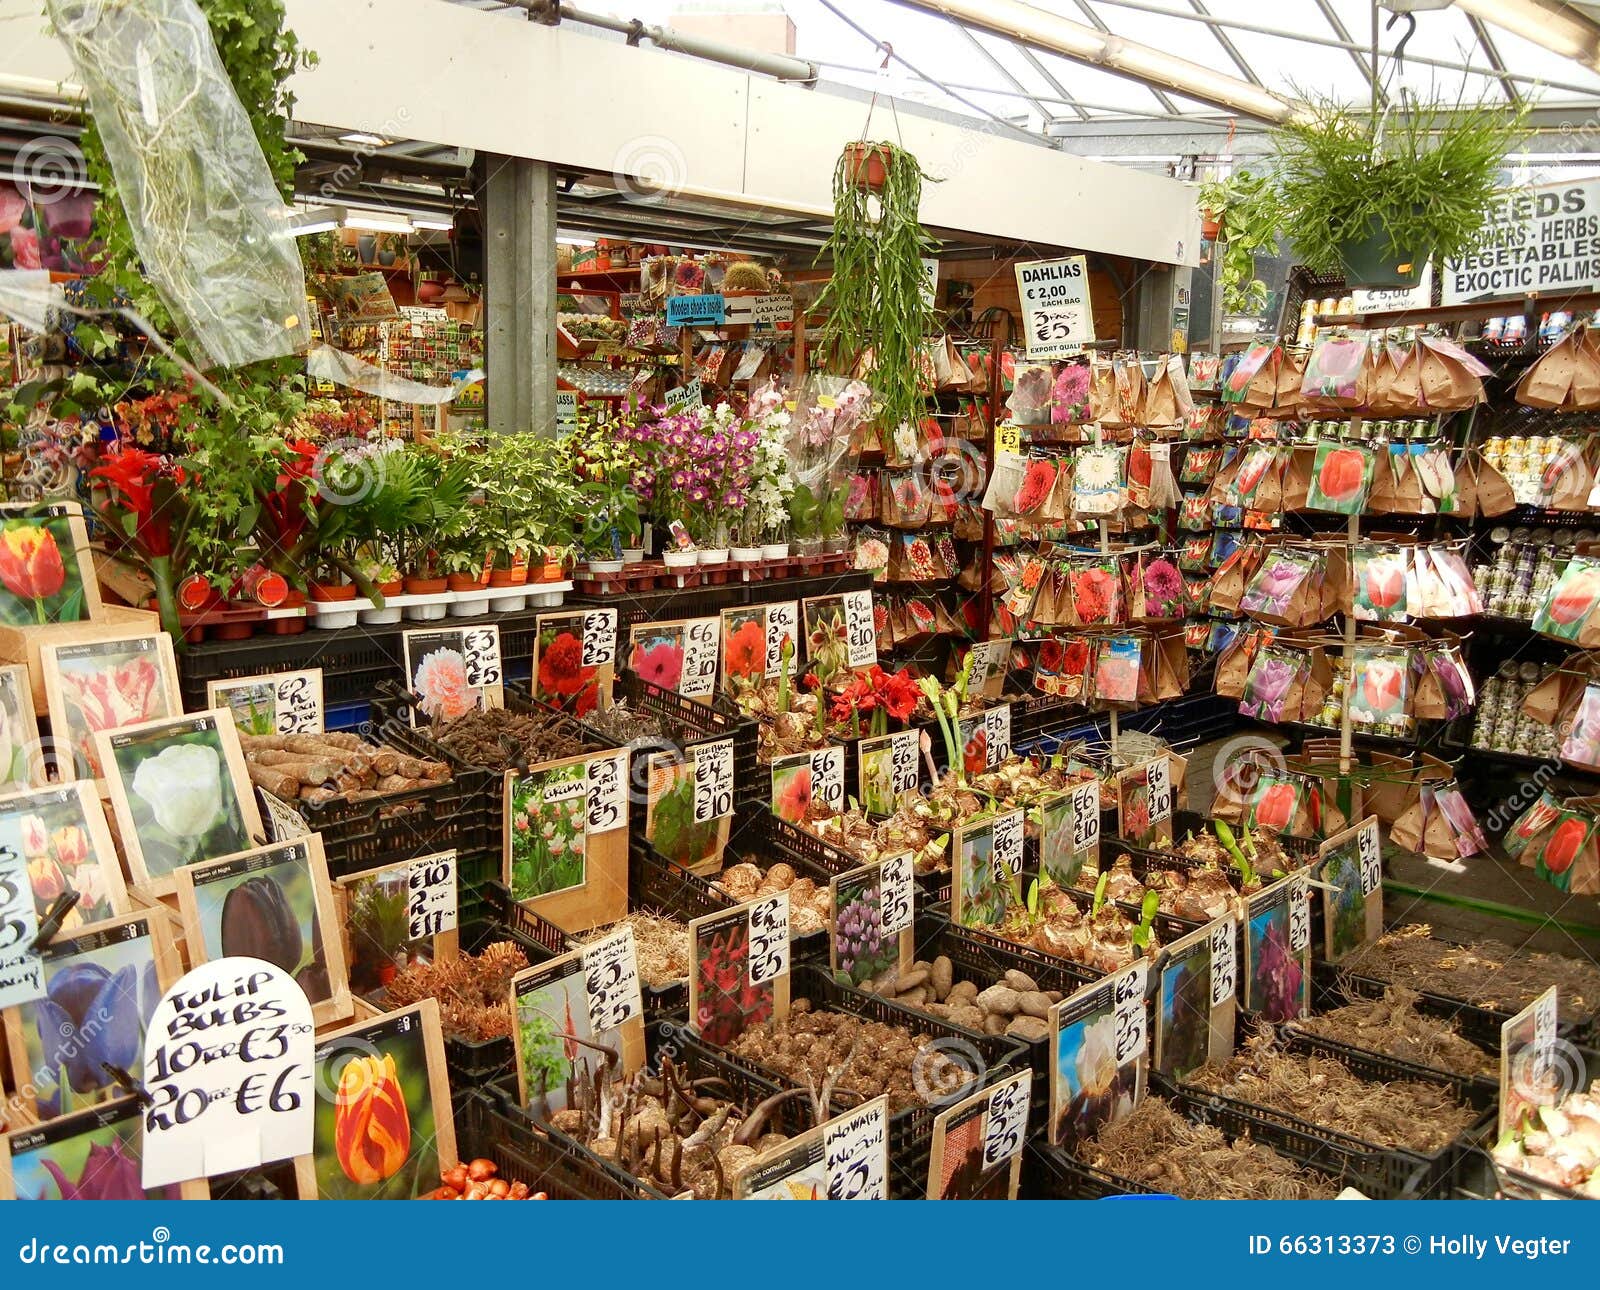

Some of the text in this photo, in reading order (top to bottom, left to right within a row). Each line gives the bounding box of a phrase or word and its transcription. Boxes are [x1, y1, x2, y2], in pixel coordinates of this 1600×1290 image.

[1484, 188, 1586, 224] EEDS
[1460, 215, 1599, 255] OWERS HERBS
[1450, 238, 1600, 273] VEGETABLES
[1022, 263, 1081, 284] DAHLIAS
[1455, 259, 1600, 293] EXOCTIC PALMS
[1039, 284, 1067, 300] 2,00
[1041, 297, 1081, 308] EACH BAG
[1030, 342, 1081, 354] EXPORT QUALI
[689, 623, 713, 642] €6
[851, 628, 873, 646] €10
[686, 660, 715, 677] €10
[696, 791, 732, 820] €10
[1074, 818, 1098, 845] €10
[409, 863, 450, 889] €10
[167, 1000, 287, 1040] BULBS
[147, 1041, 202, 1084] 10
[146, 1084, 210, 1133] 20
